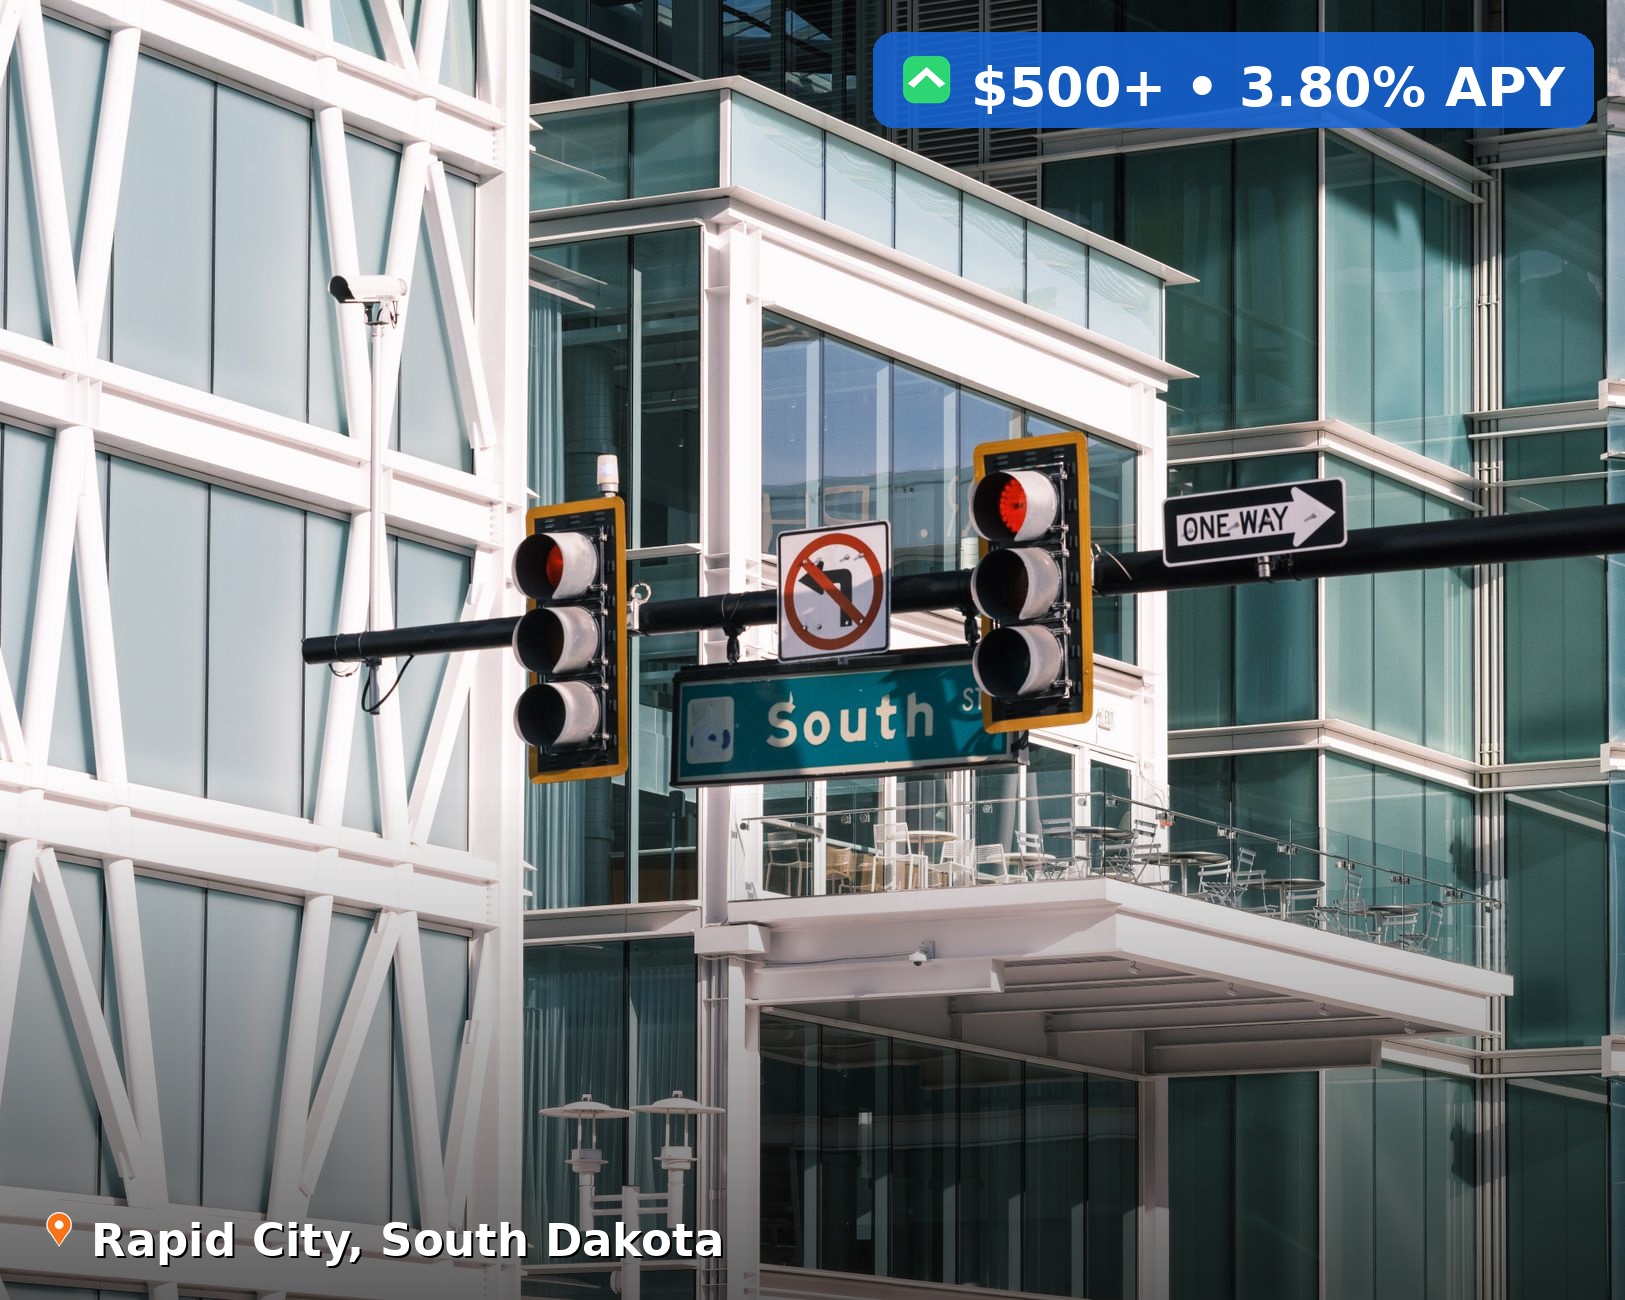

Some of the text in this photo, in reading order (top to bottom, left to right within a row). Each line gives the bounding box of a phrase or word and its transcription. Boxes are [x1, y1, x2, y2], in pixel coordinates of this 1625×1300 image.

[1183, 505, 1289, 542] ONE WAY
[766, 691, 934, 748] South
